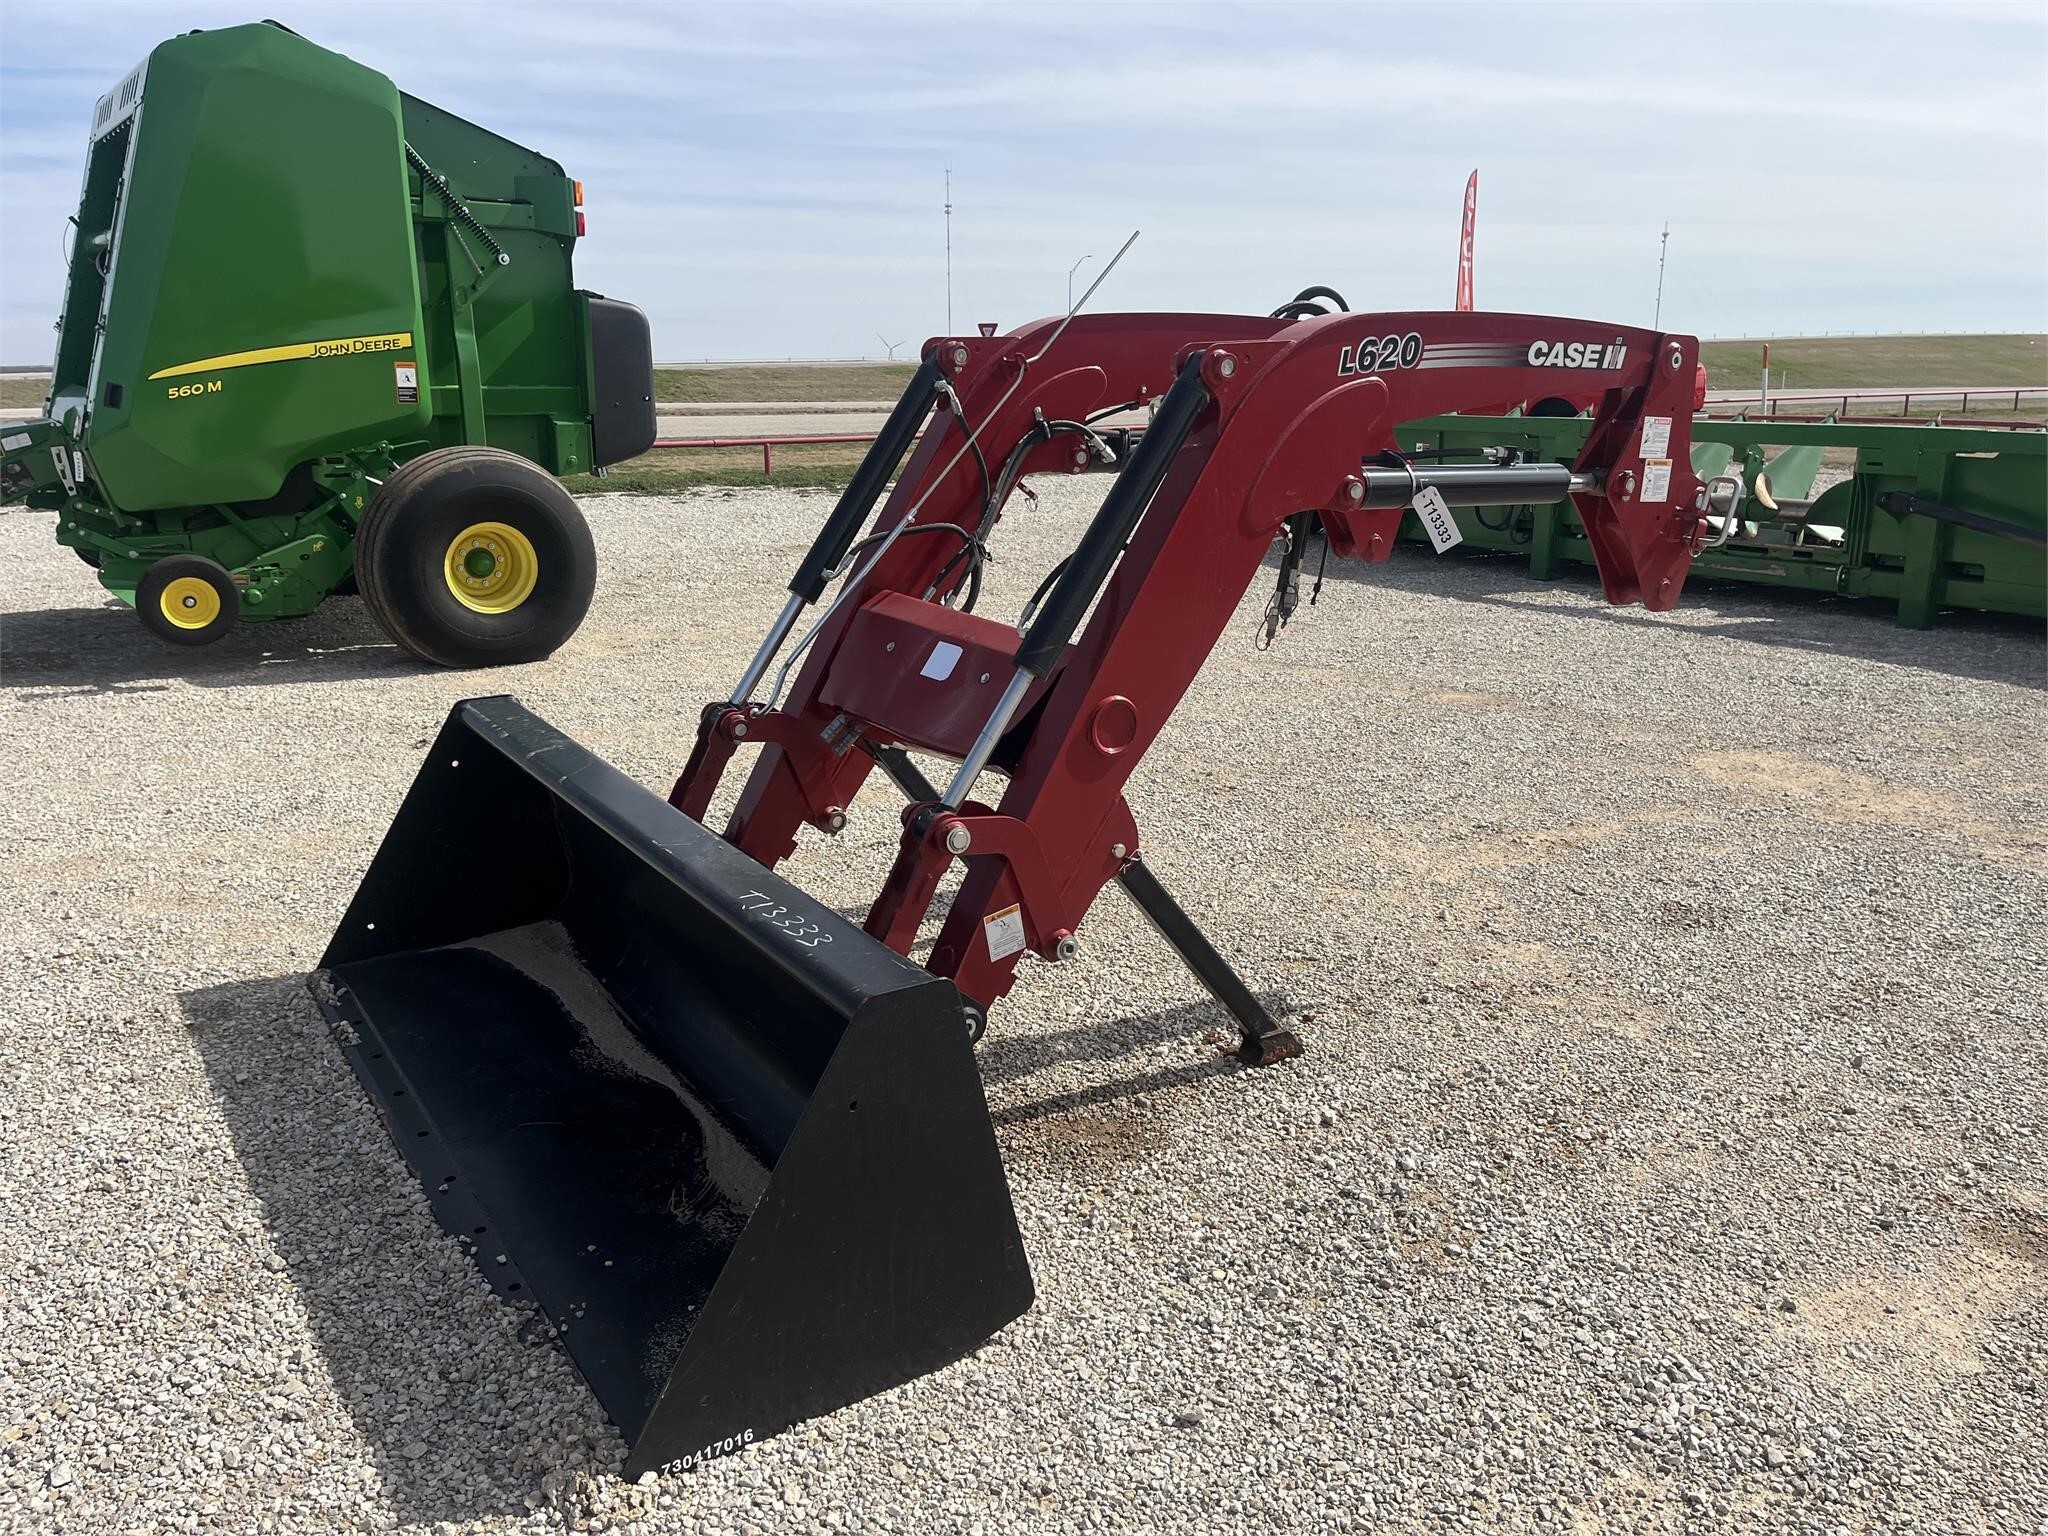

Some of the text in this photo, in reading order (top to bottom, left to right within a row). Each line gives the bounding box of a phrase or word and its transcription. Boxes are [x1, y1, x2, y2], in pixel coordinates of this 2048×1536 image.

[310, 338, 401, 358] JOHN DEERE
[1338, 332, 1423, 377] L620
[1527, 340, 1602, 368] CASE
[168, 380, 222, 400] 560 M
[1423, 498, 1452, 544] T13333
[738, 889, 833, 947] T13333
[661, 1428, 754, 1476] 730417016
